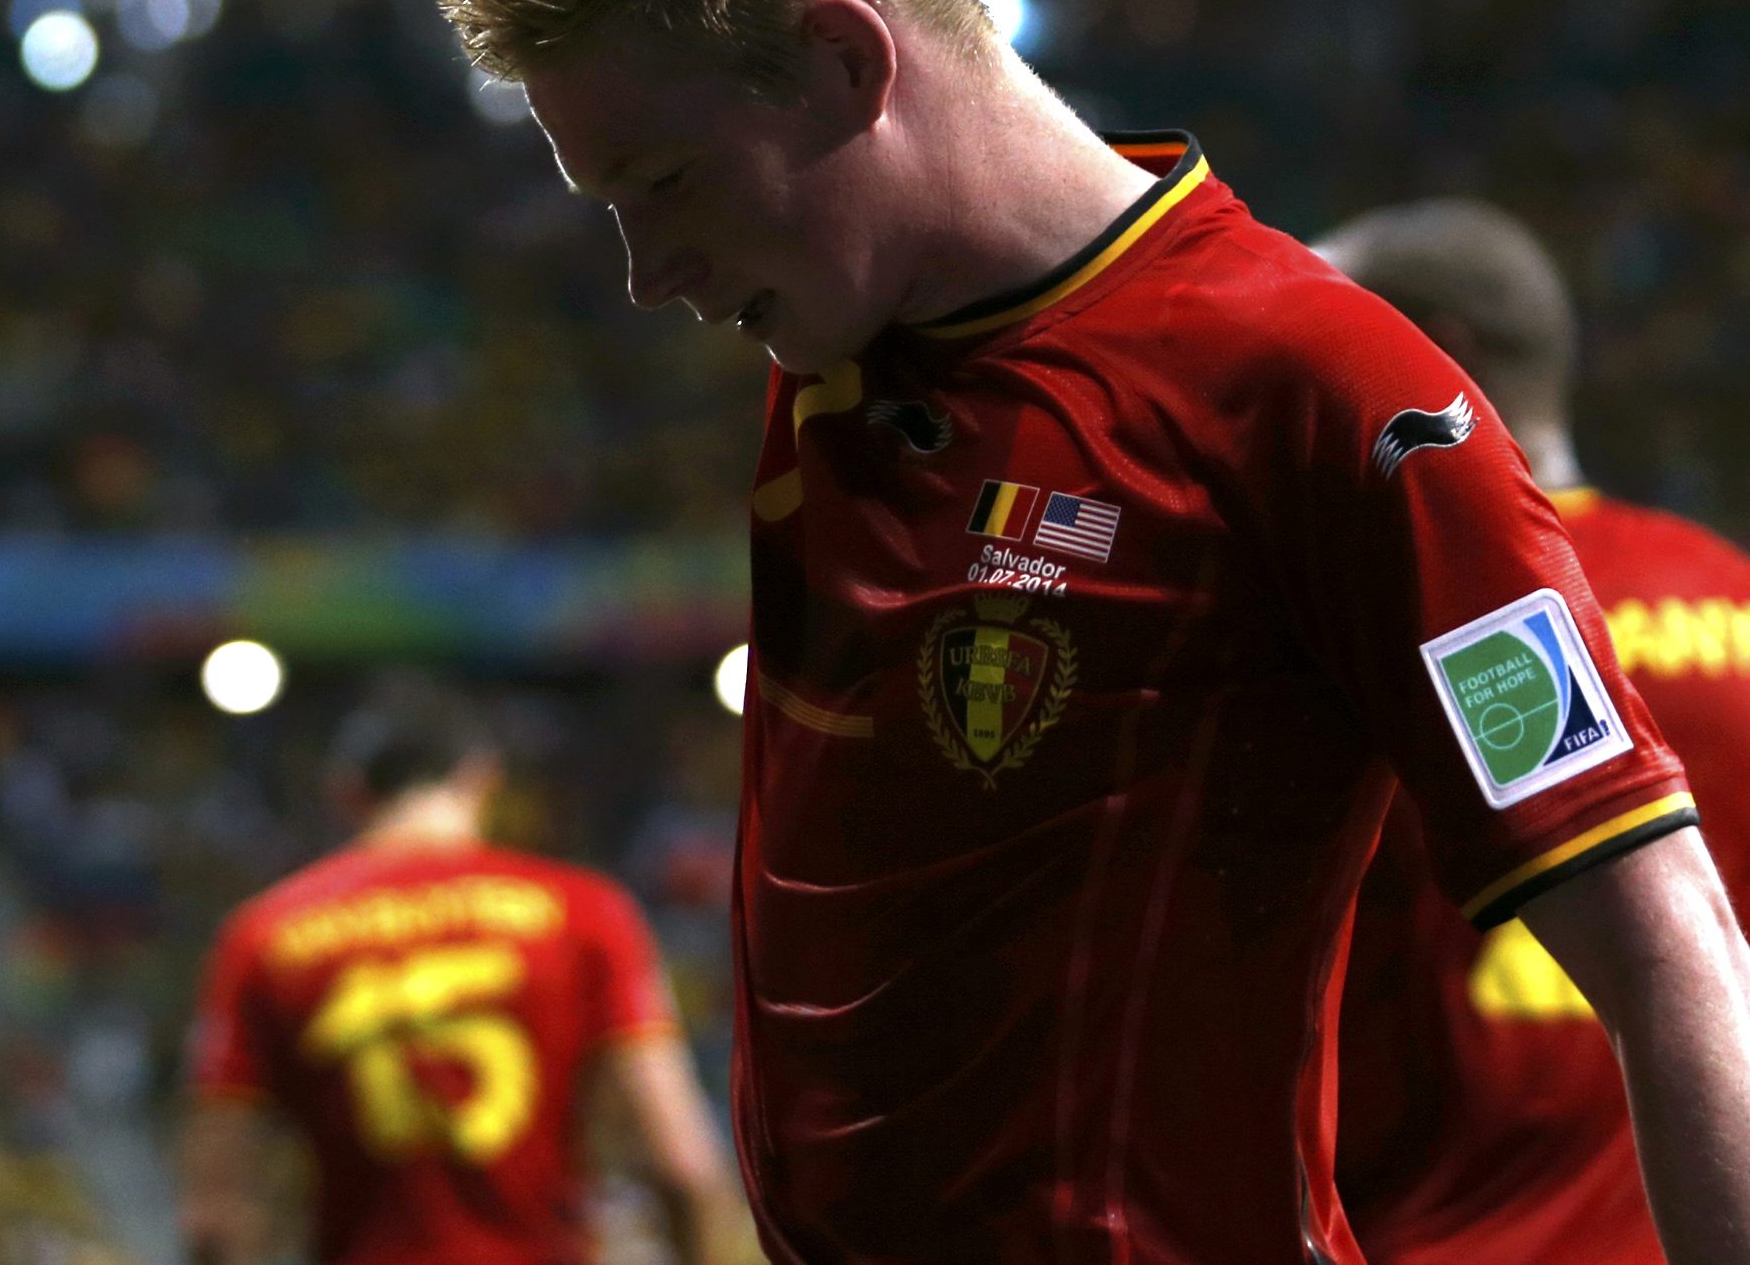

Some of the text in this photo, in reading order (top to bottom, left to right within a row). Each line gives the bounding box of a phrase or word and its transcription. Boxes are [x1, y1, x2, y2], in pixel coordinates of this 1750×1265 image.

[981, 544, 1066, 579] Salvador
[967, 562, 1068, 597] 01.07.2014
[949, 646, 1031, 676] URBSFA
[1457, 652, 1535, 695] FOOTBALL
[1463, 668, 1537, 709] FOR HOPE
[1563, 726, 1601, 752] FIFA
[306, 942, 540, 1166] 15
